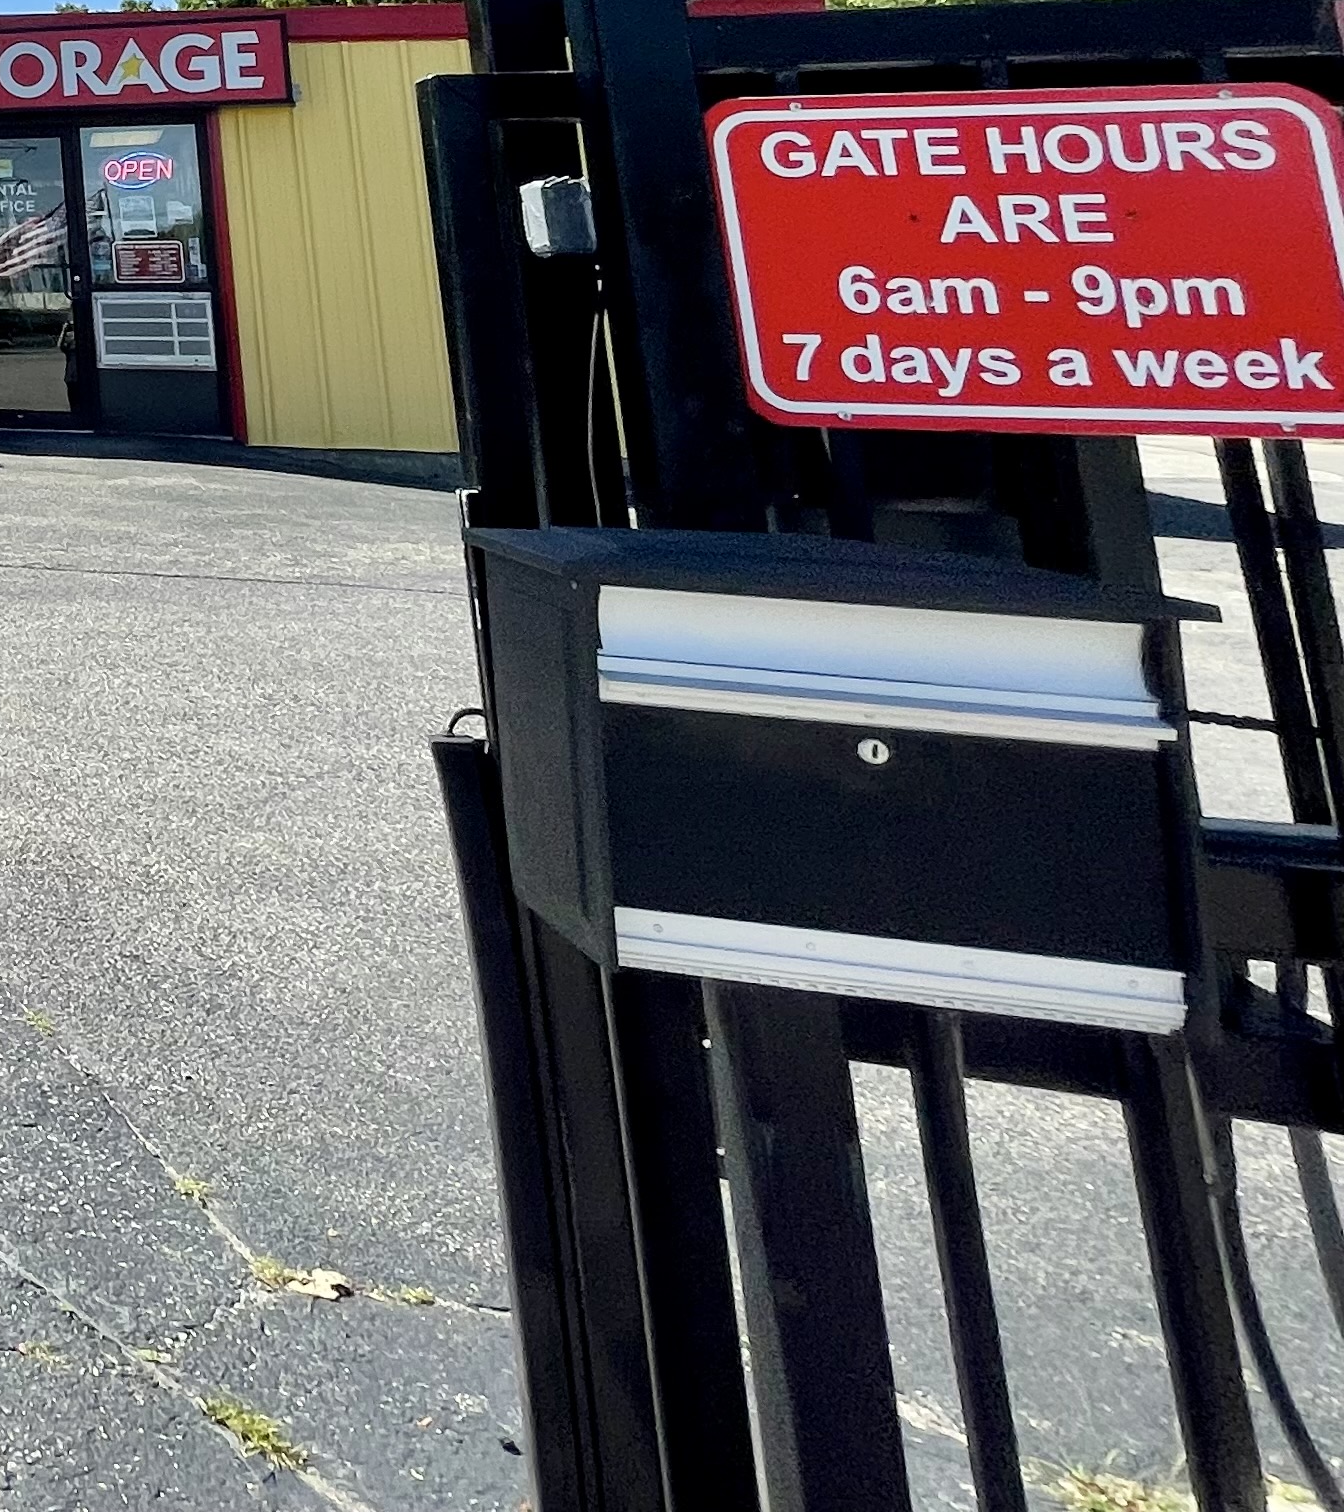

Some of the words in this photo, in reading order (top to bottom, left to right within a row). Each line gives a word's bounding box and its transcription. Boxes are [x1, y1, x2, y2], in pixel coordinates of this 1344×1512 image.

[104, 159, 173, 181] OPEN
[760, 125, 966, 178] GATE
[985, 120, 1278, 175] HOURS
[940, 193, 1116, 243] ARE
[838, 265, 1001, 315] 6am
[1023, 288, 1050, 304] -
[1070, 264, 1246, 328] 9pm
[782, 333, 822, 381] 7
[839, 334, 1022, 397] days
[1047, 348, 1092, 387] a
[1113, 337, 1335, 390] week
